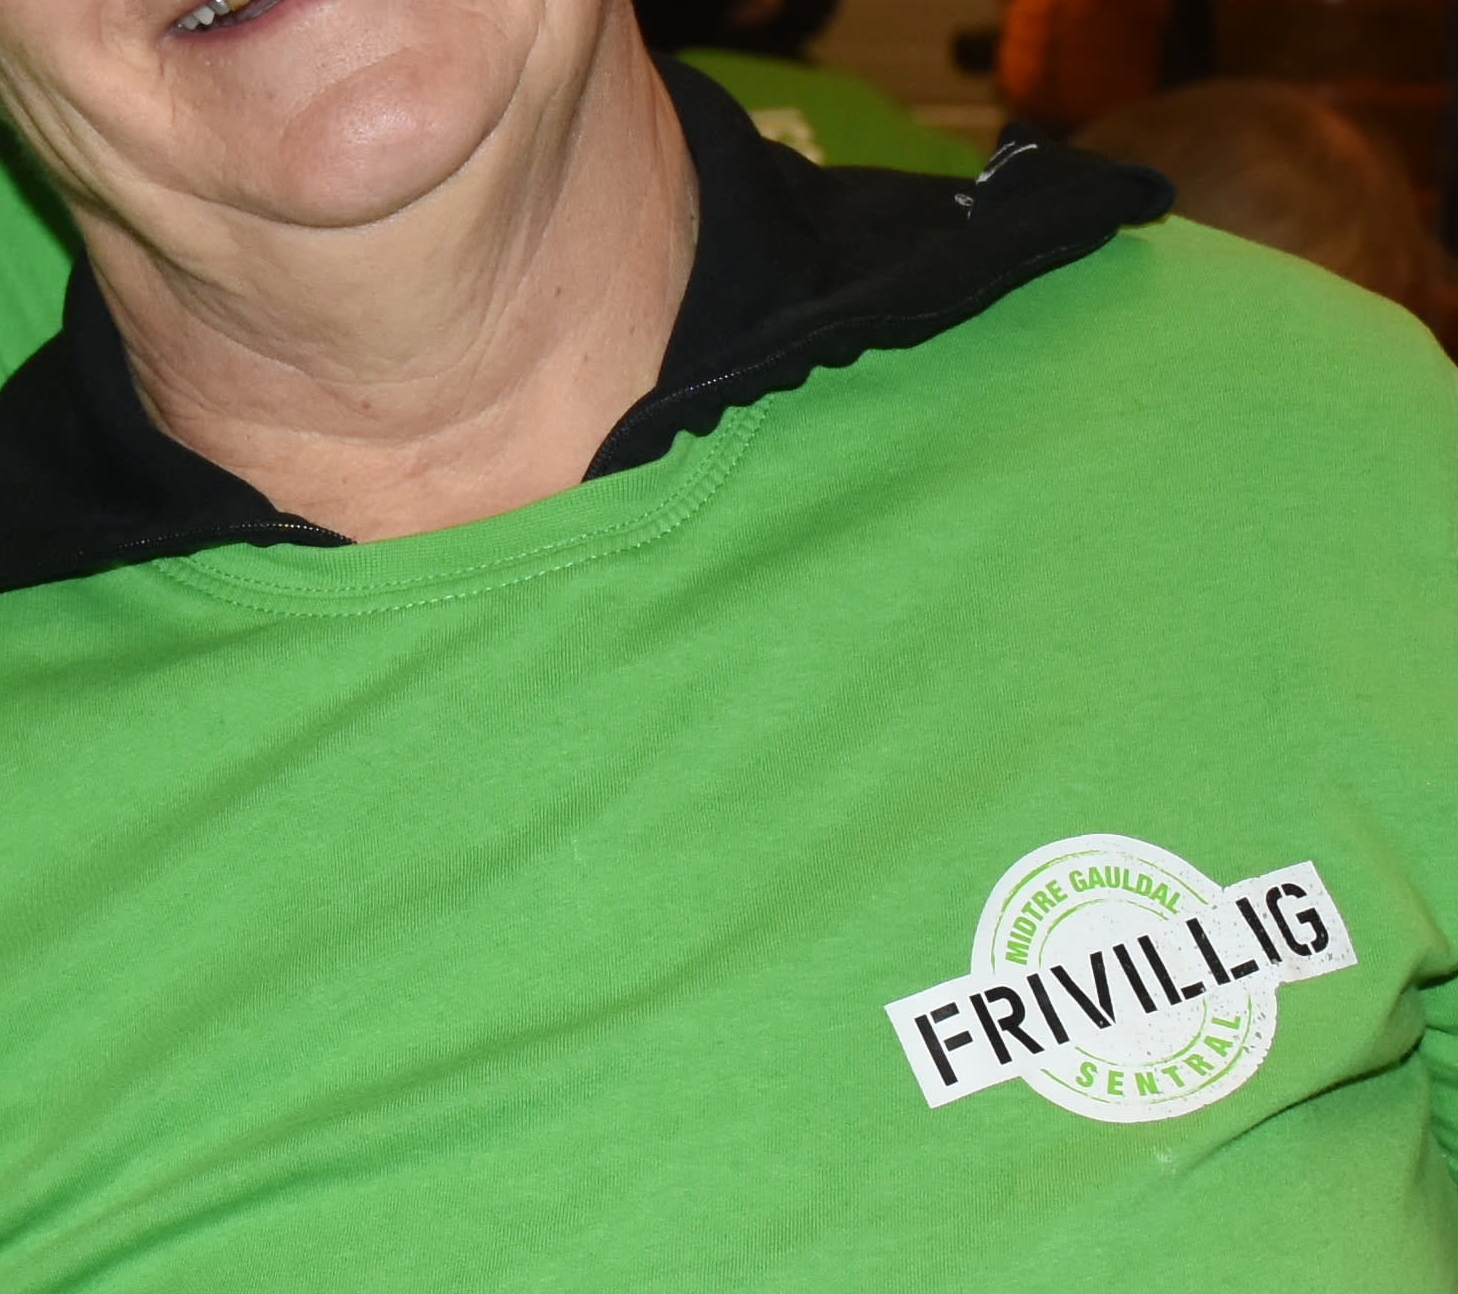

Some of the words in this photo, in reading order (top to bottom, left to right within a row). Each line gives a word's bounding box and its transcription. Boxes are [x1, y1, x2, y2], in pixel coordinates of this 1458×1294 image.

[1004, 877, 1068, 966] MIDTRE
[1068, 865, 1182, 914] GAULDAL
[913, 882, 1331, 1087] FRIVILLIG
[1075, 1011, 1241, 1097] SENTRAL
